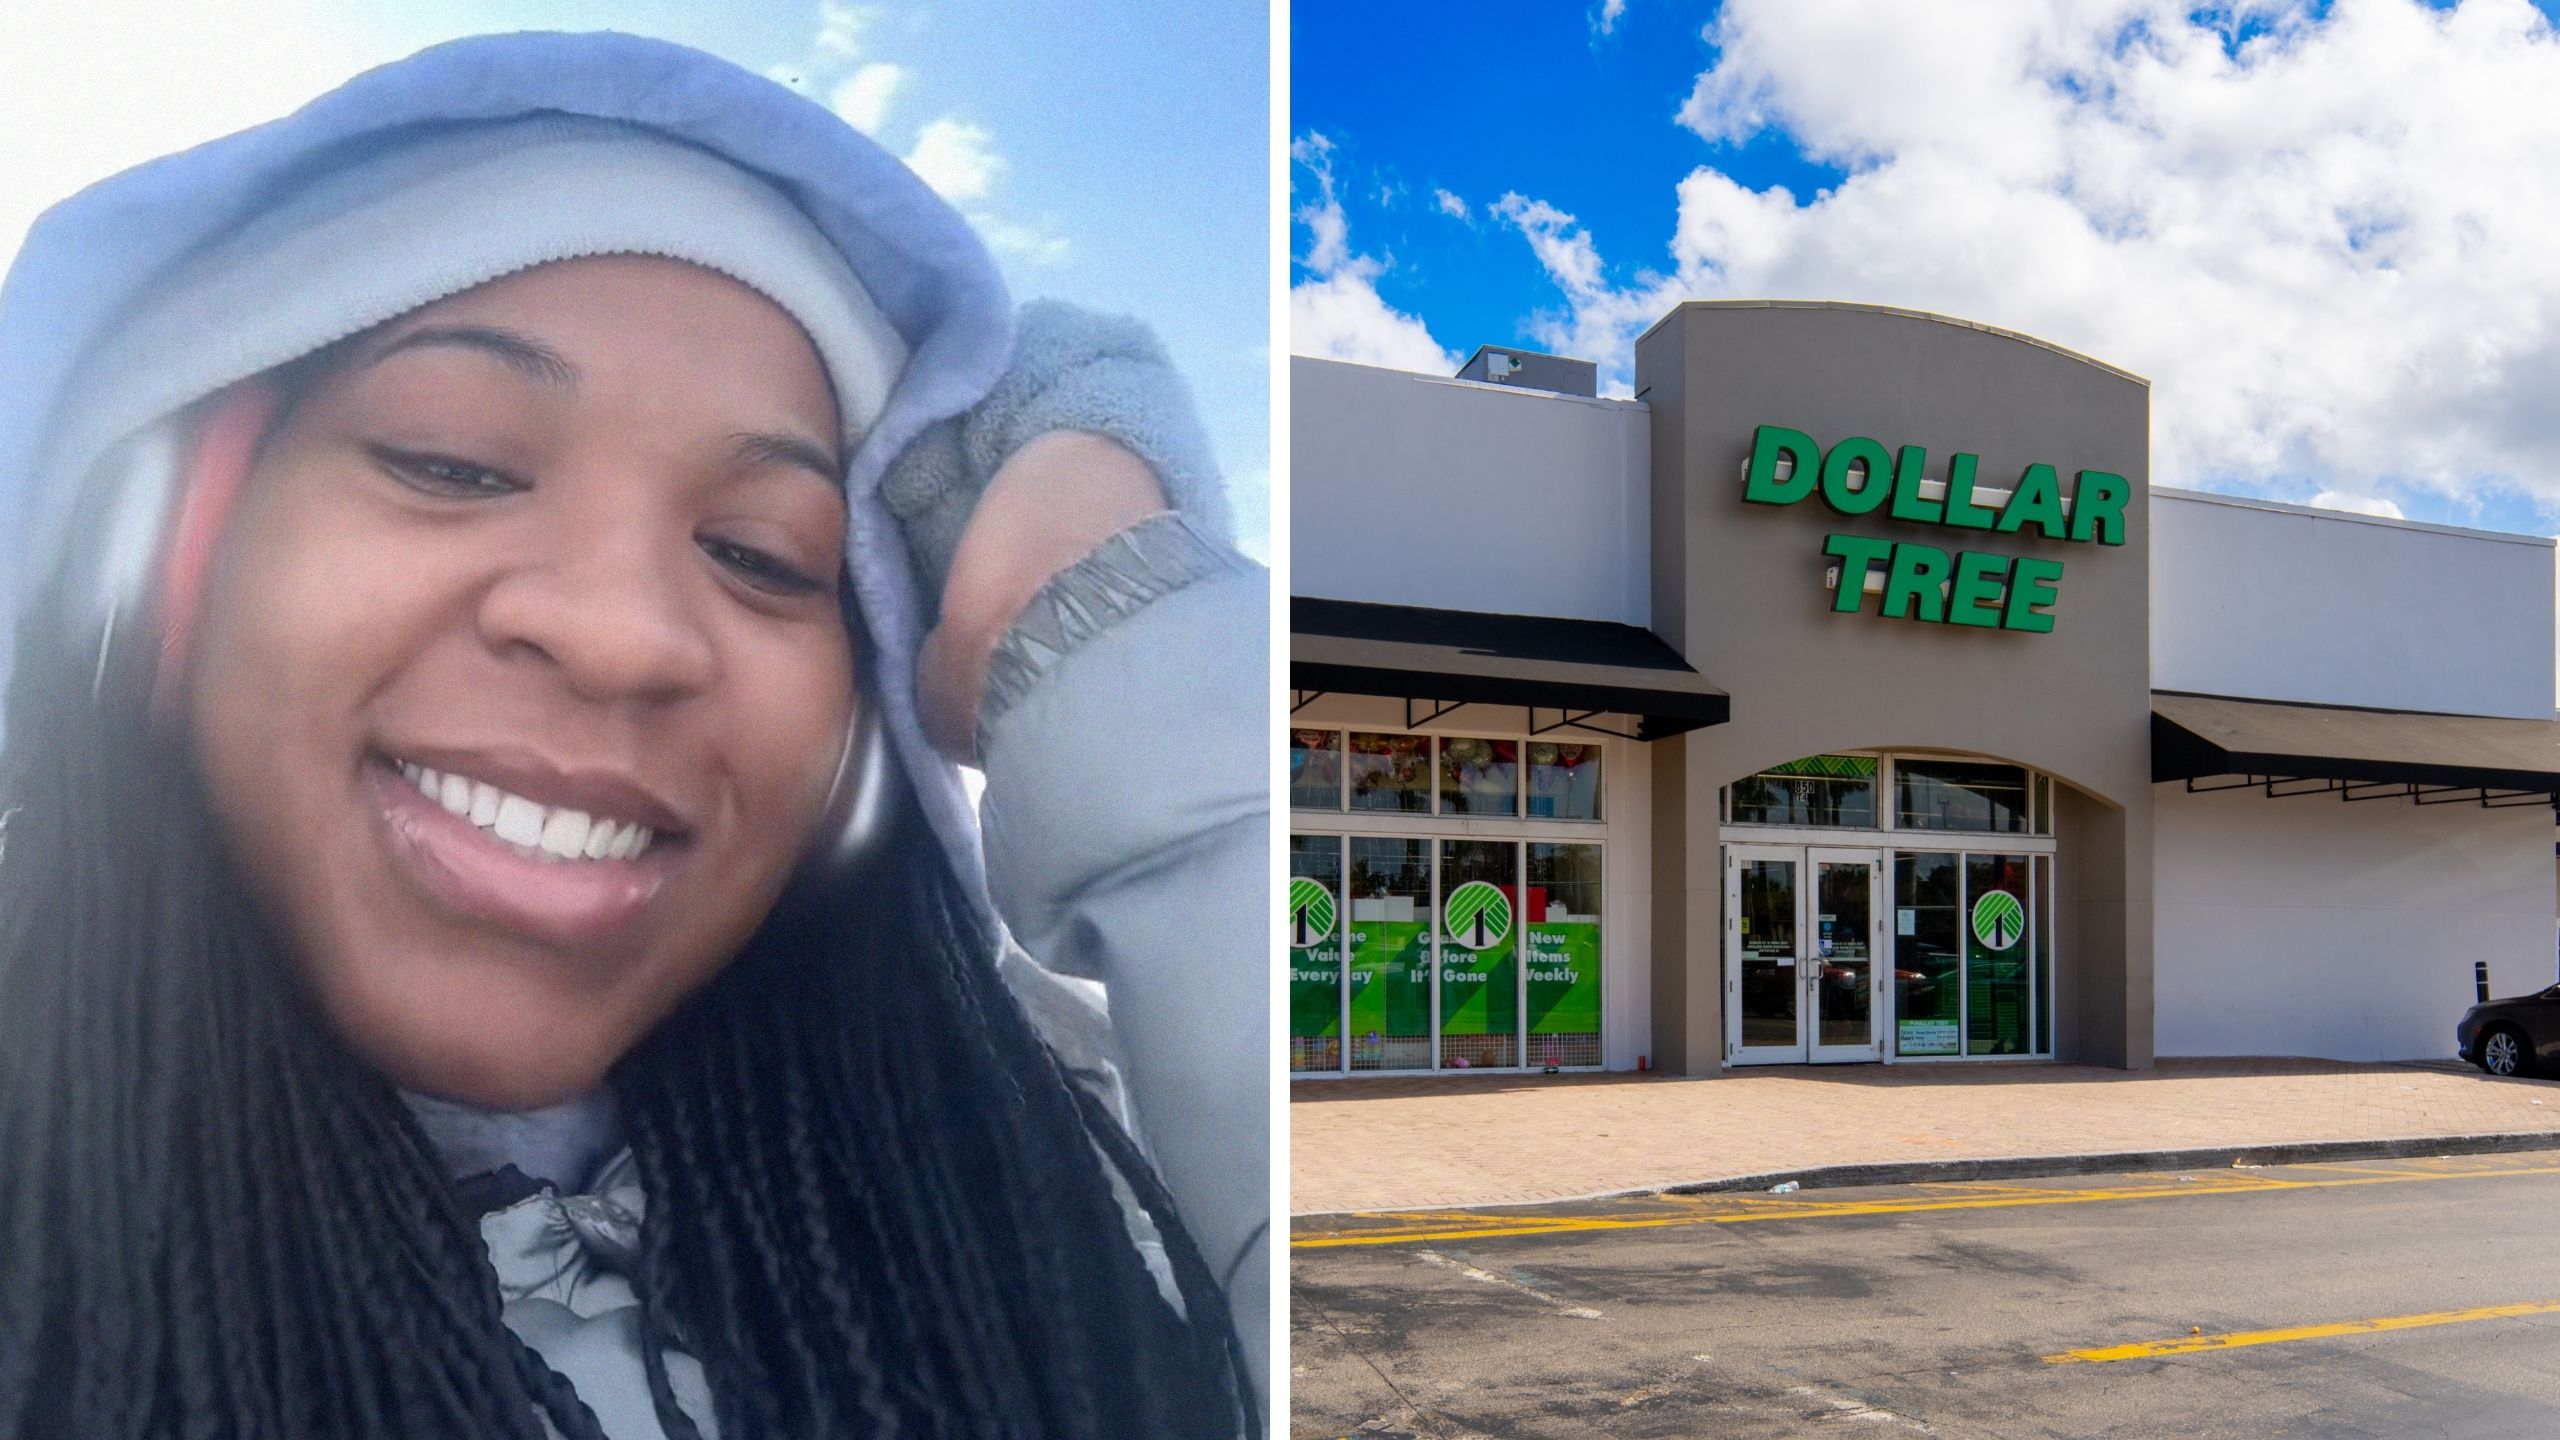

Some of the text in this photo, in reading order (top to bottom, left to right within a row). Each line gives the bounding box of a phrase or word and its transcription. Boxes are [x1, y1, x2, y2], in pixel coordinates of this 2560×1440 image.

[1742, 425, 2131, 546] DOLLAR
[1822, 534, 2064, 633] TREE
[1529, 931, 1566, 944] New
[1420, 949, 1478, 963] Bfore
[1526, 949, 1571, 963] Items
[1290, 967, 1373, 984] Everyay
[1443, 968, 1487, 982] Gone
